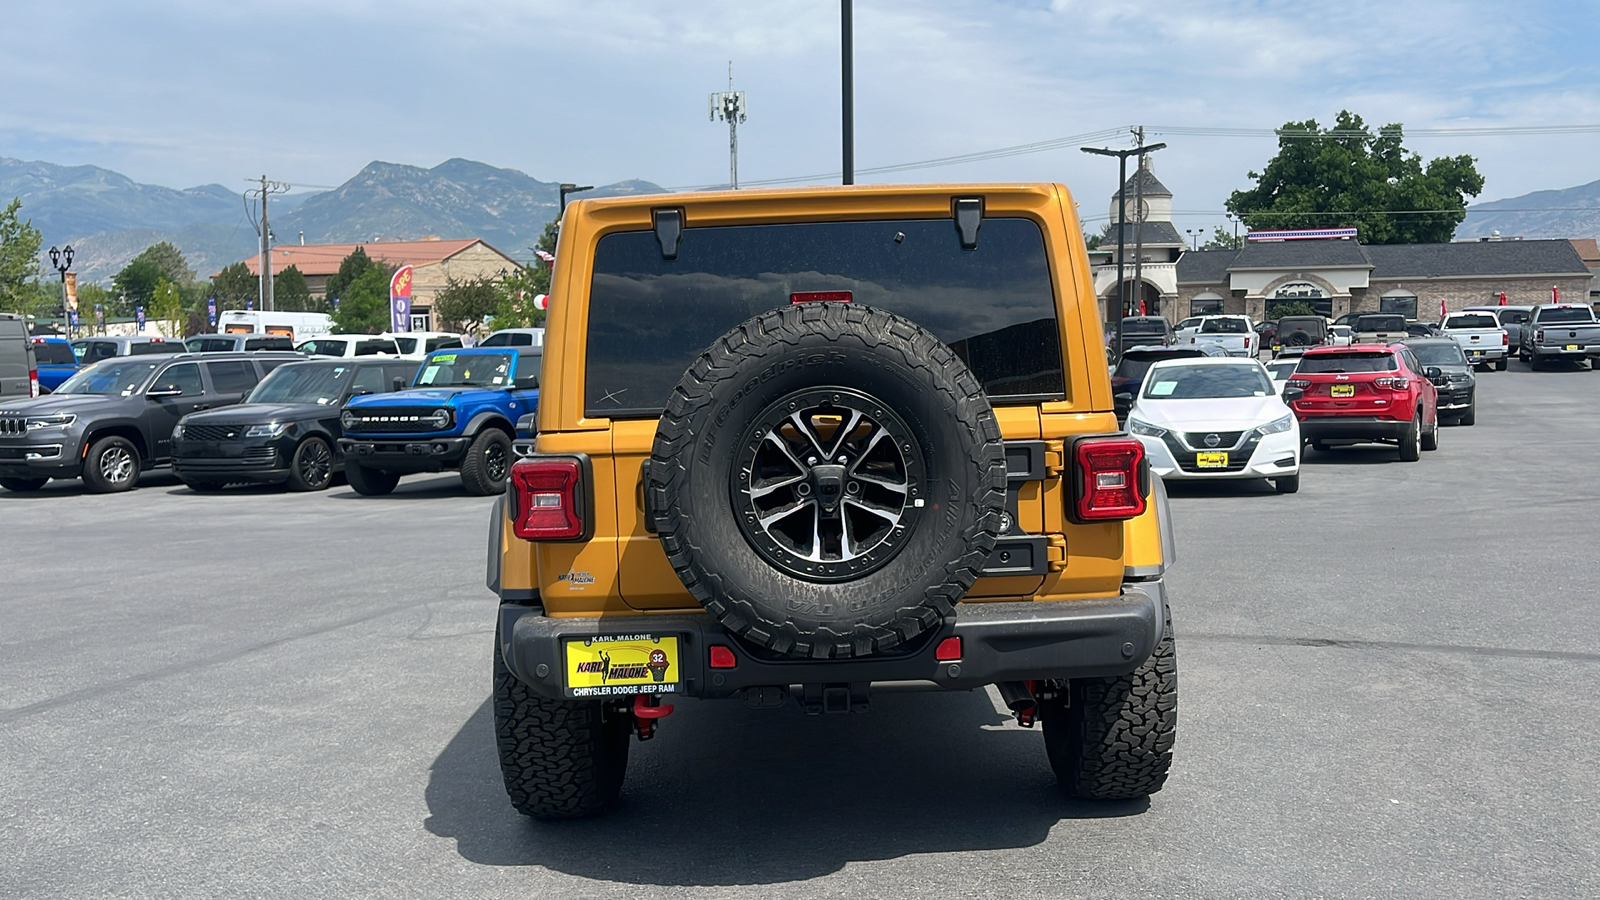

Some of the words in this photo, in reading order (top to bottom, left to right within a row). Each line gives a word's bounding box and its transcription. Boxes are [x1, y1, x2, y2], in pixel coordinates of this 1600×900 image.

[395, 269, 410, 296] PRE
[652, 654, 664, 663] 32
[576, 662, 604, 673] KARL
[608, 667, 649, 679] MALONE
[573, 687, 611, 697] CHRYSLER
[612, 685, 638, 695] DODGE
[639, 684, 657, 694] JEEP
[658, 684, 675, 693] RAM
